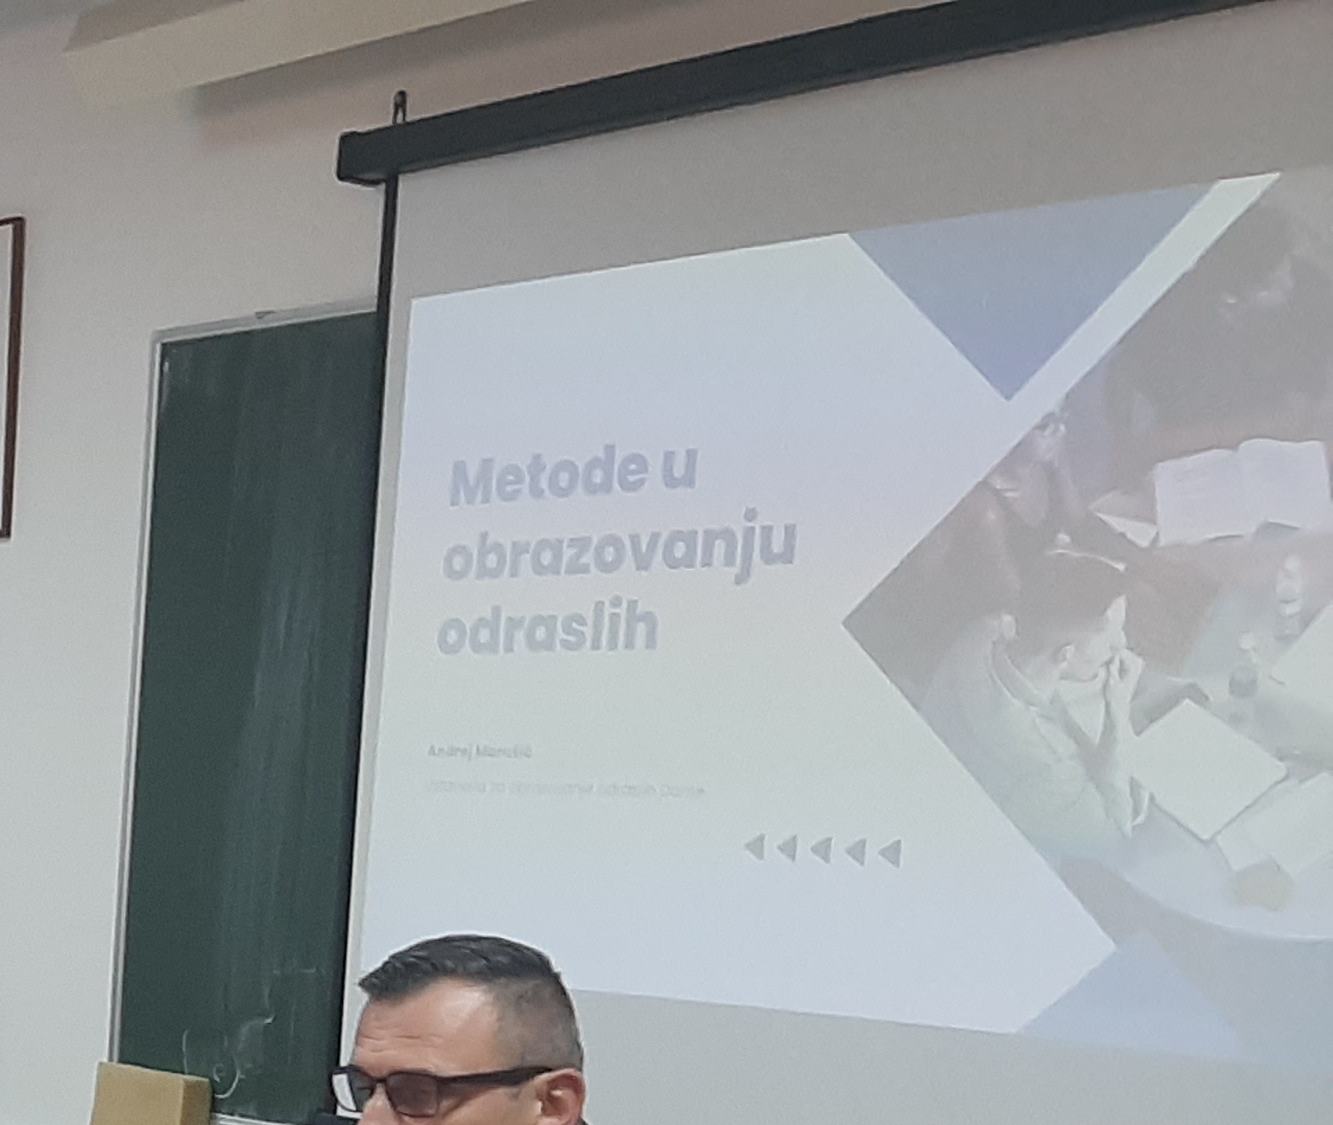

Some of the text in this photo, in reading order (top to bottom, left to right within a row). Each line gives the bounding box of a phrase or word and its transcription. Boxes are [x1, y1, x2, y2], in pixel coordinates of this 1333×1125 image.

[449, 443, 698, 506] Metode u
[442, 506, 798, 586] obrazovanju
[436, 595, 659, 656] odraslih
